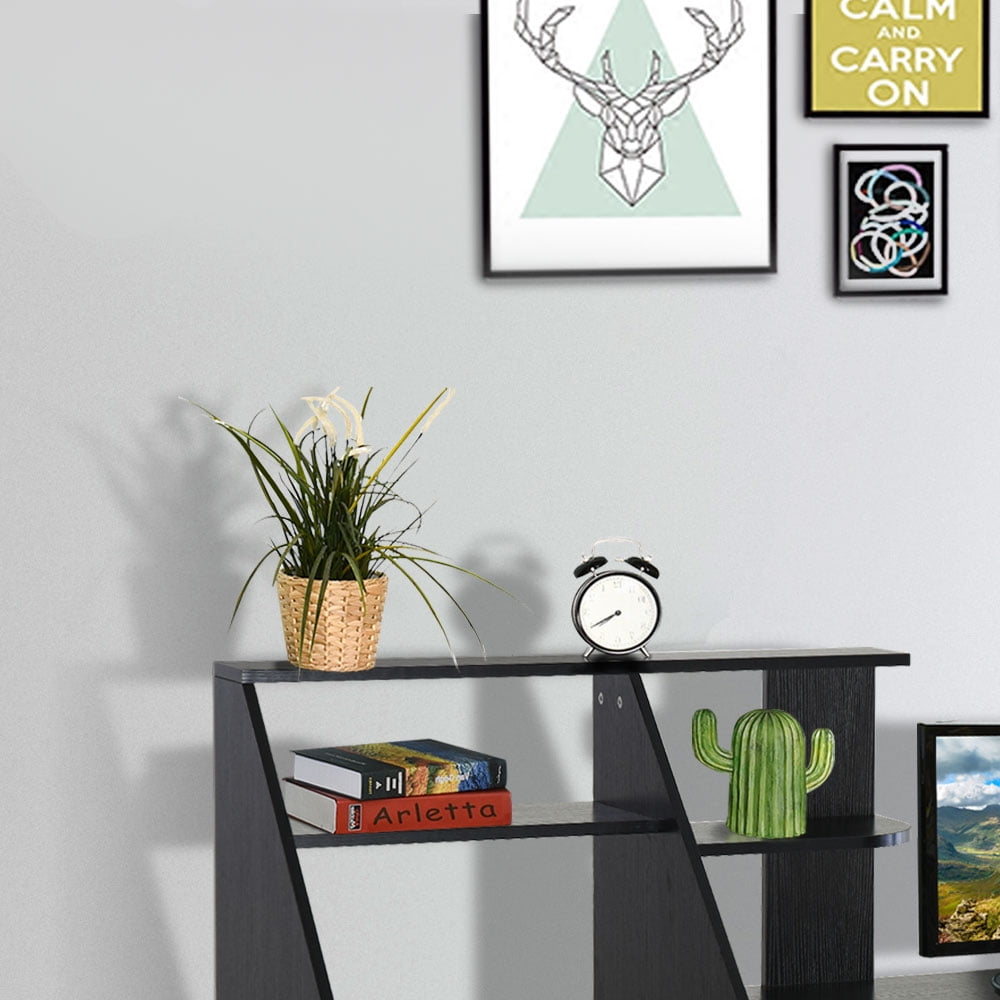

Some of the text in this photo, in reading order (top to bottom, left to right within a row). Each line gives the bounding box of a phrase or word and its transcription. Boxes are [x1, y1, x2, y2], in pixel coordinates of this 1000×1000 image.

[839, 0, 956, 20] CALM
[876, 26, 921, 39] AND
[830, 46, 963, 73] CARRY
[867, 79, 929, 107] ON
[373, 802, 497, 826] Arletta
